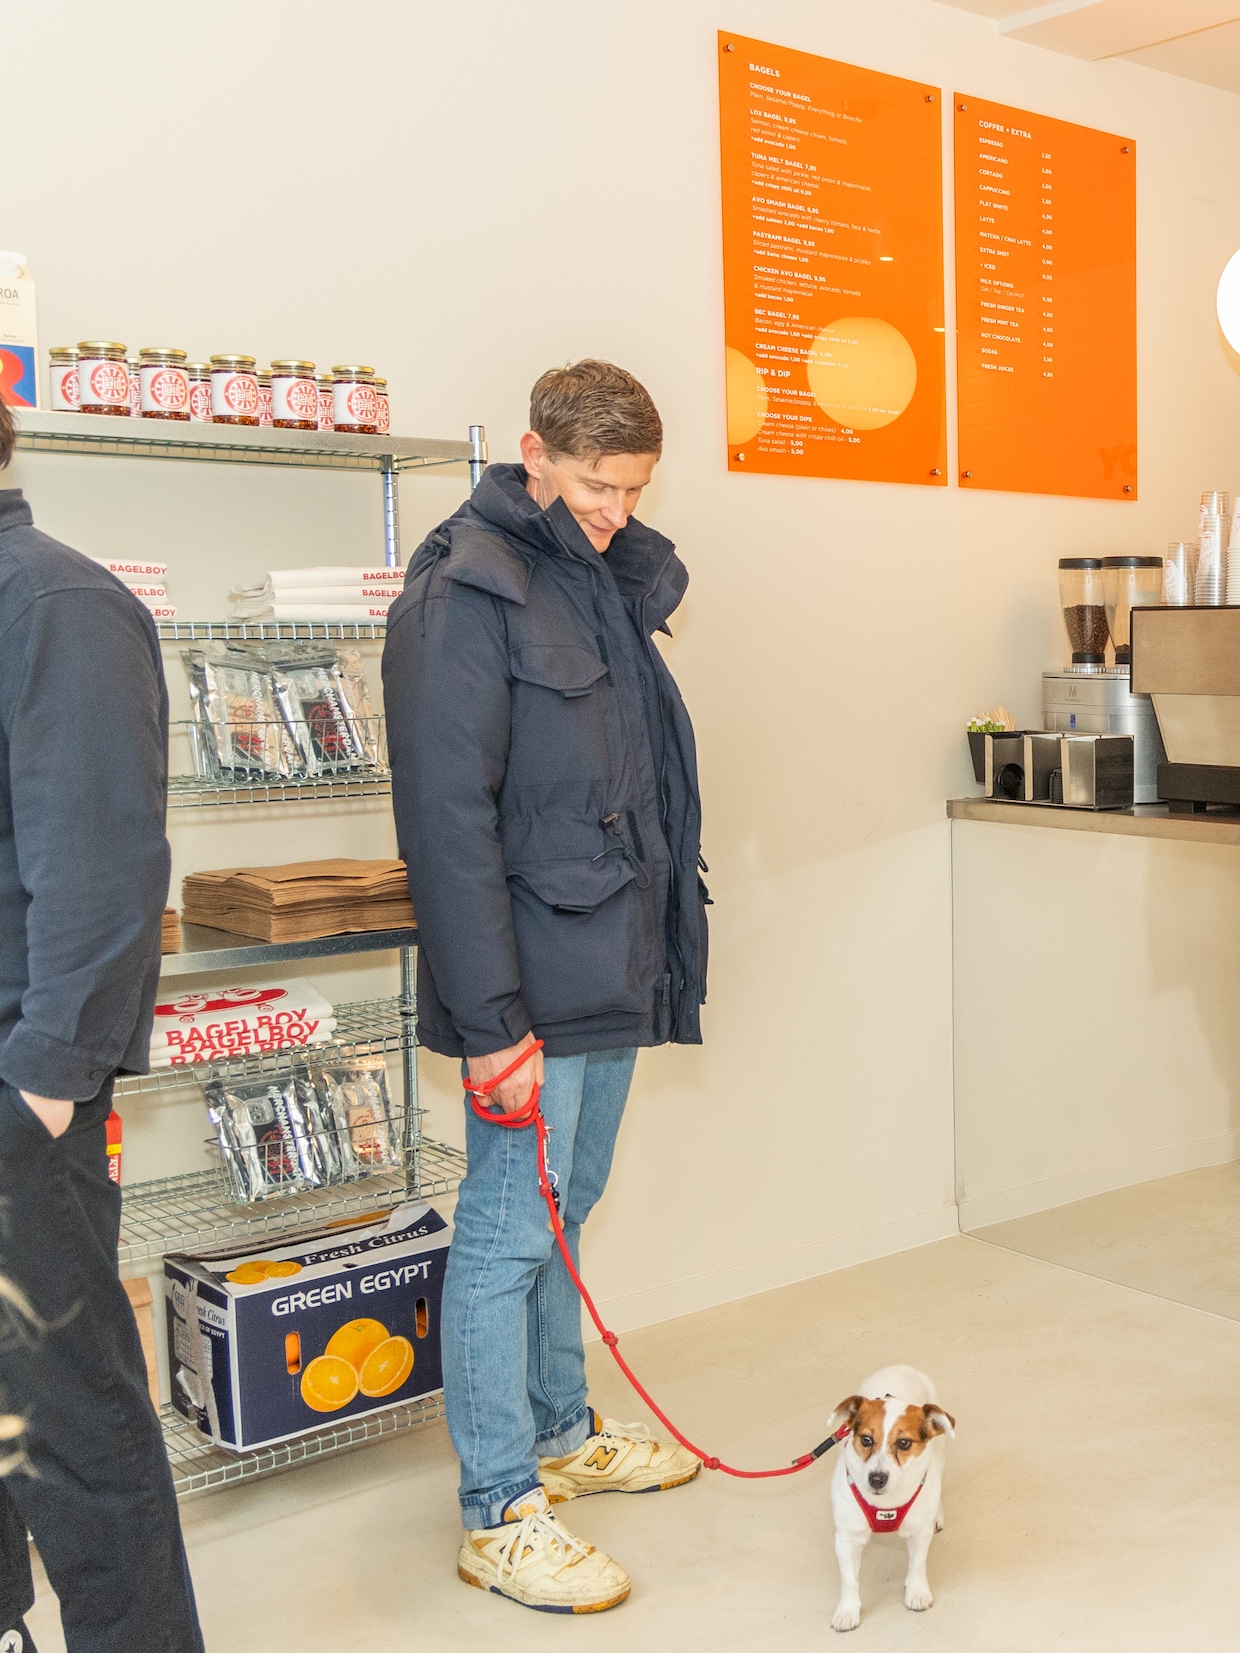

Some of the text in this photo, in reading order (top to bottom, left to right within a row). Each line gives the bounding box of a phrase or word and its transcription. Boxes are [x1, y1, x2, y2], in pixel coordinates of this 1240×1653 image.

[749, 63, 780, 77] BAGELS
[749, 83, 811, 102] CHOOSE YOUR BAGEL
[750, 109, 796, 124] LOX BAGEL 9,95
[751, 153, 767, 161] TUNA
[768, 156, 783, 165] MELT
[785, 160, 803, 169] BAGEL
[752, 196, 819, 214] AVO SMASH BAGEL 8,95
[753, 231, 782, 241] PASTRAMI
[783, 236, 801, 245] BAGEL
[753, 266, 779, 275] CHICKEN
[794, 272, 812, 280] BAGEL
[767, 310, 786, 318] BAGEL
[756, 367, 768, 376] RIP
[777, 370, 790, 378] DIP
[757, 386, 780, 394] CHOOSE
[798, 390, 816, 398] BAGEL
[110, 564, 167, 575] BAGELBOY
[363, 571, 406, 580] BAGELBO
[130, 588, 166, 596] GELBO
[180, 1021, 319, 1054] BAGELBOY
[304, 1225, 429, 1265] Fresh Citrus
[272, 1261, 432, 1316] GREEN EGYPT
[208, 1310, 225, 1325] Citrus
[583, 1445, 618, 1470] N
